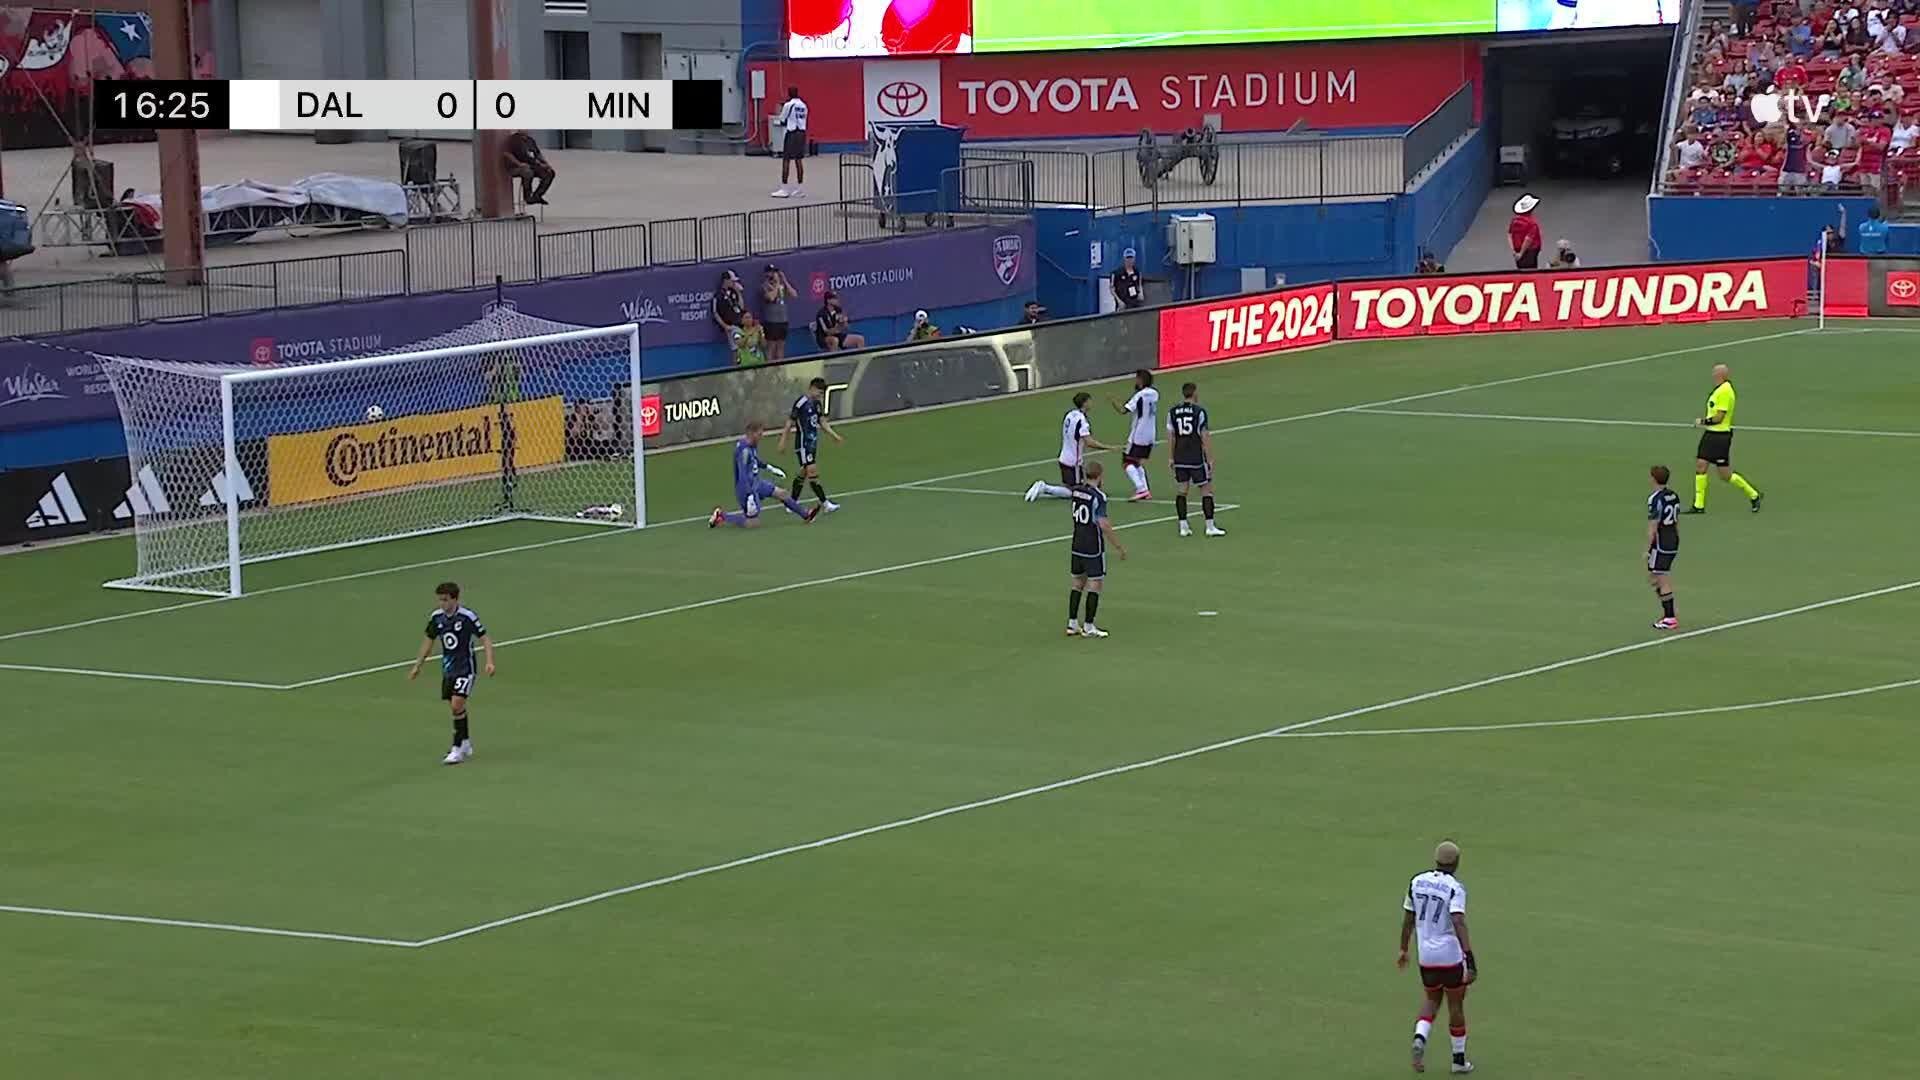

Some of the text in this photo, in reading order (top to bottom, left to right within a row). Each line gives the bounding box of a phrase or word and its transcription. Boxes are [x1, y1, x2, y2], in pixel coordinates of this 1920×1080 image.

[959, 69, 1356, 115] TOYOTA STADIUM
[829, 267, 913, 289] TOYOTA STADIUM
[667, 294, 694, 304] WORLD
[1350, 269, 1768, 330] TOYOTA TUNDRA
[681, 310, 707, 321] RESORT
[1208, 292, 1334, 352] THE 2024
[277, 335, 381, 359] TOYOTA STADIUM
[664, 397, 720, 422] TUNDRA
[1176, 416, 1193, 436] 15
[325, 415, 493, 487] Continental
[454, 677, 469, 689] 57
[1415, 892, 1445, 924] 77
